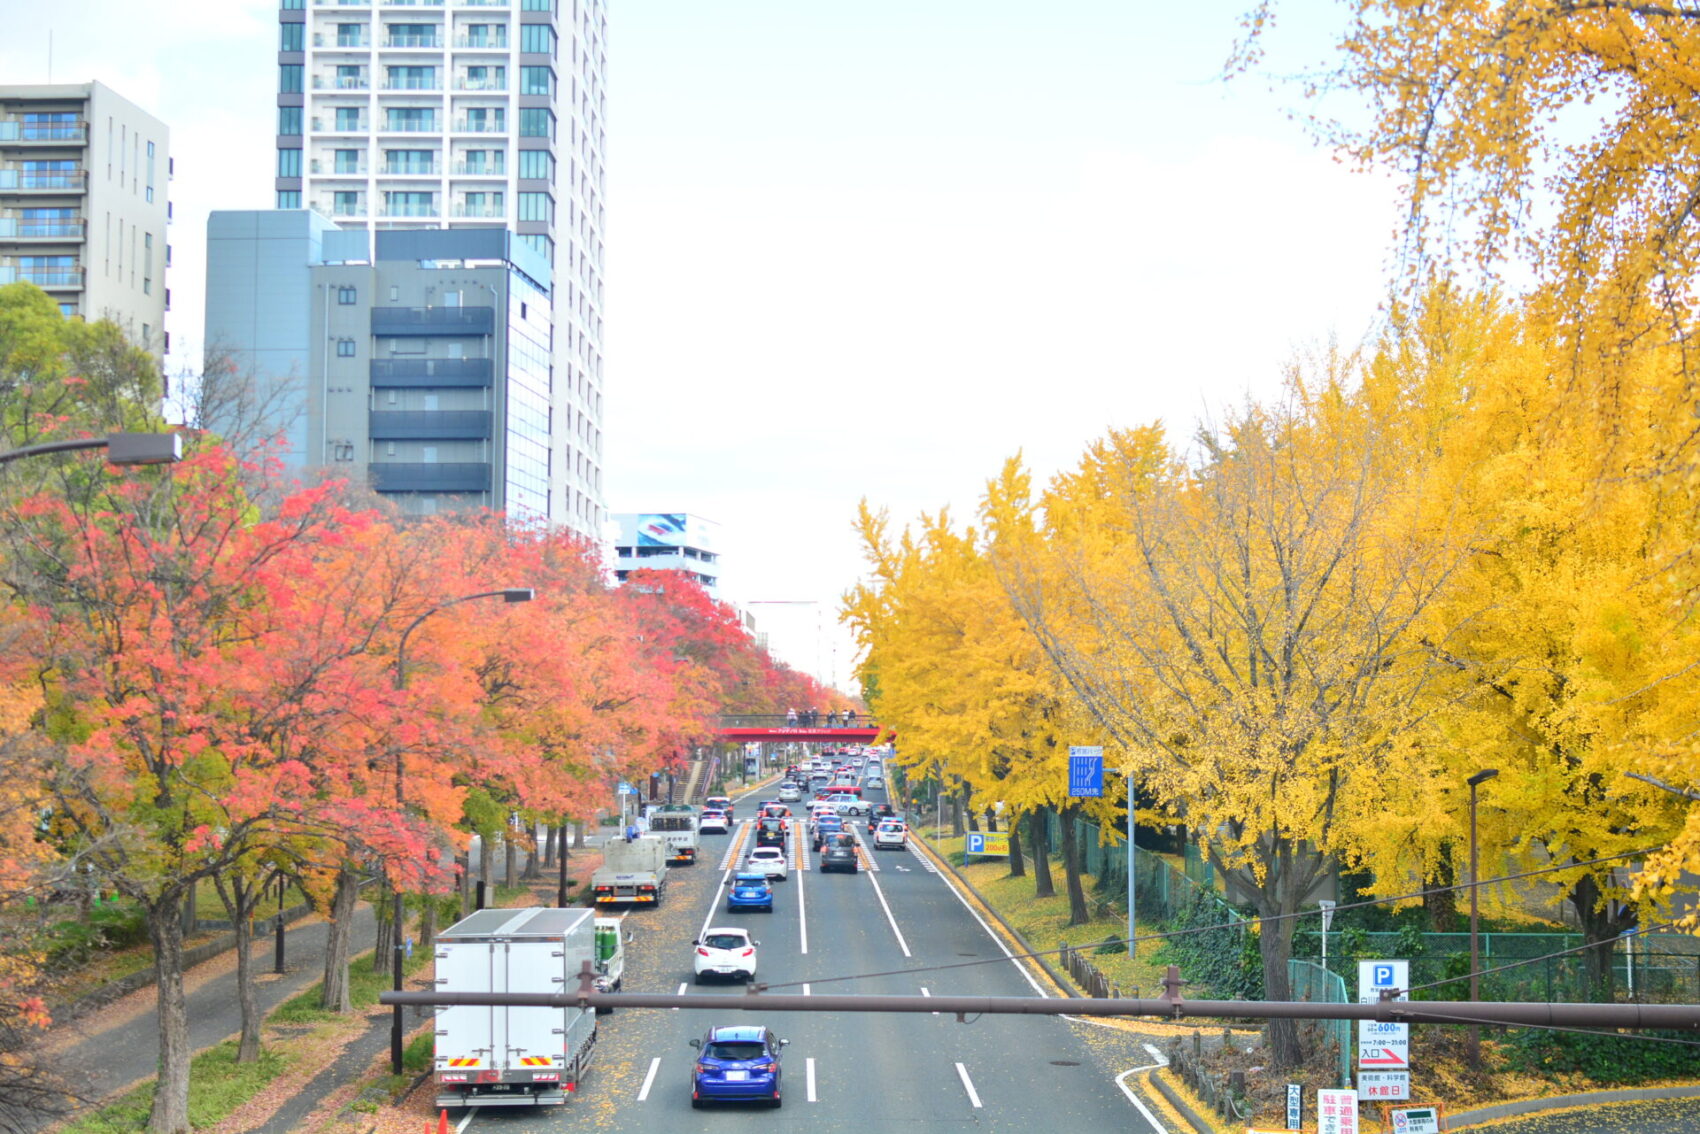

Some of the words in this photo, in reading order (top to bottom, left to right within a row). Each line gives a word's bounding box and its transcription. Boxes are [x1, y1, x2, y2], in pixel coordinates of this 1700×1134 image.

[970, 835, 982, 852] P
[1377, 967, 1390, 984] P
[1361, 1048, 1380, 1058] 入口
[1368, 1085, 1400, 1096] 休館日
[1289, 1085, 1299, 1129] 大型専用
[1323, 1094, 1337, 1134] 駐車でき
